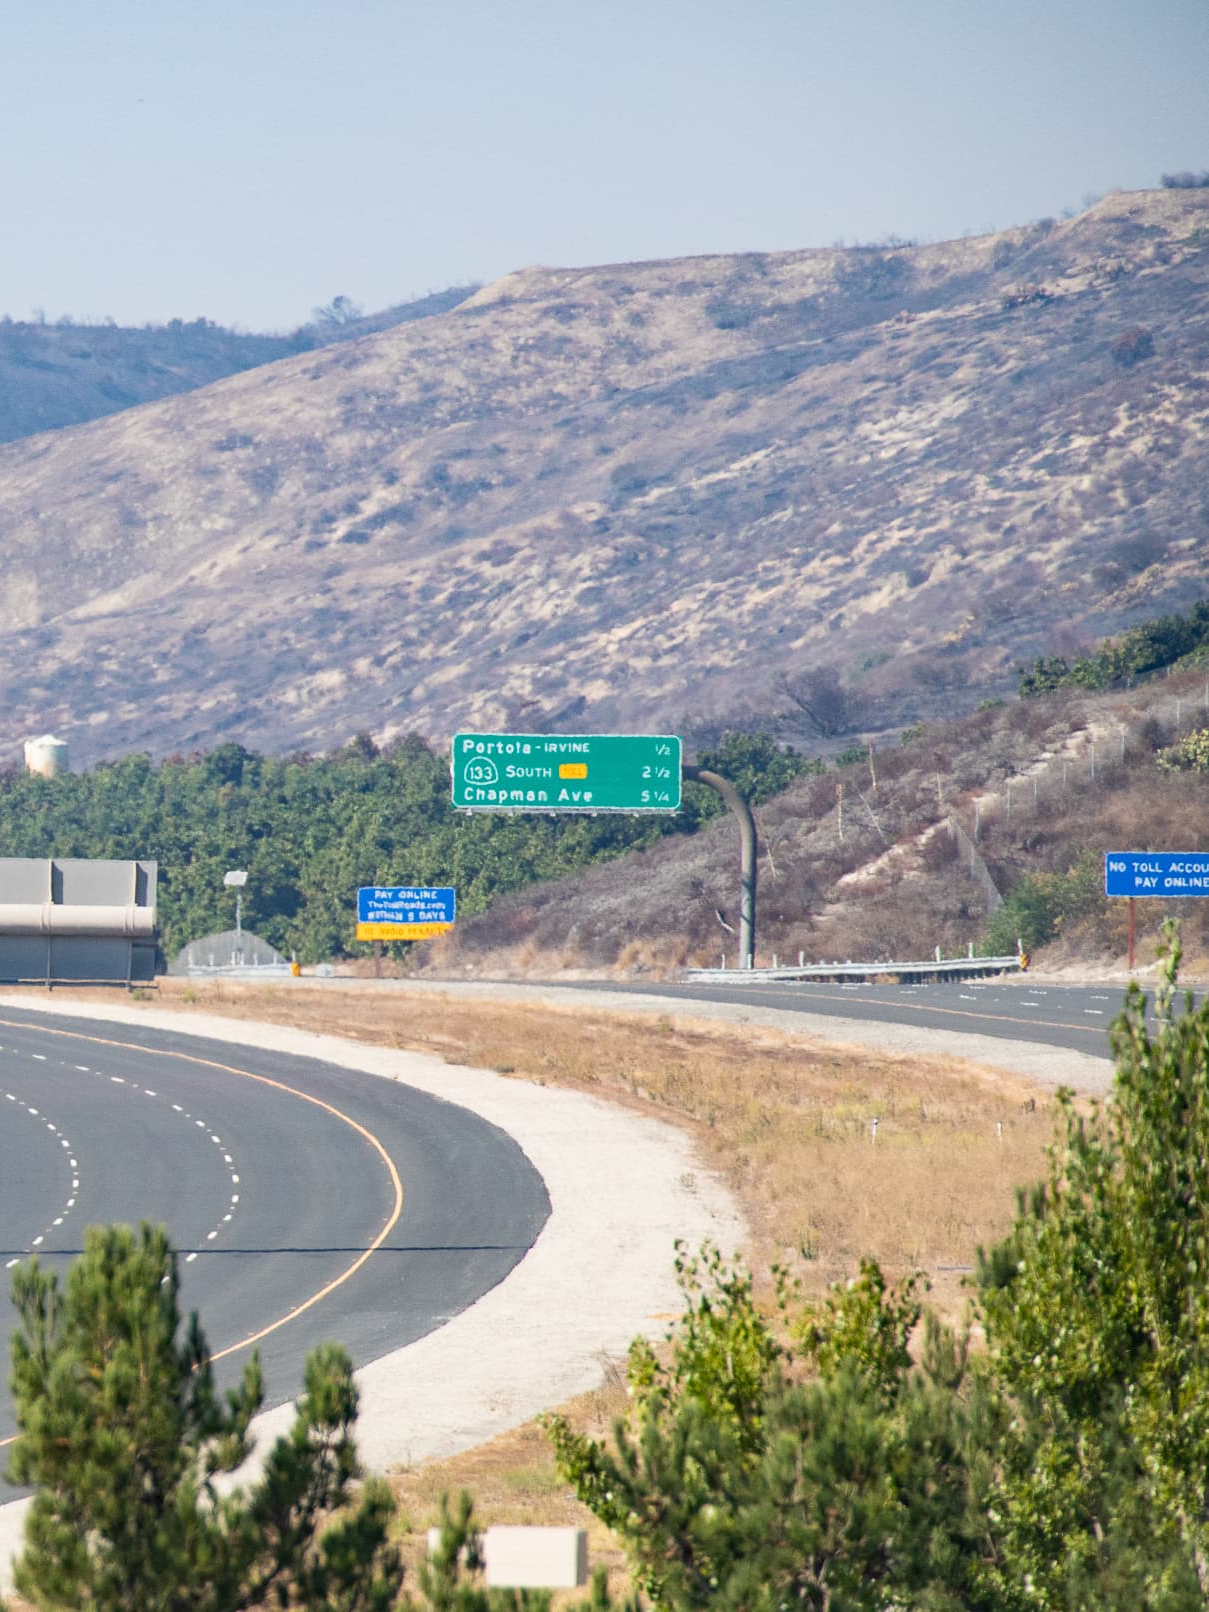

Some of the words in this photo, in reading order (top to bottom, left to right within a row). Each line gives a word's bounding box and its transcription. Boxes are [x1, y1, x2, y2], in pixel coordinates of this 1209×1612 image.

[462, 740, 531, 754] Portola
[544, 743, 590, 753] IRVINE
[470, 767, 493, 780] 133
[505, 765, 552, 777] SOUTH
[642, 766, 651, 778] 2
[464, 788, 548, 803] Chapman
[558, 789, 593, 802] Ave
[1109, 861, 1126, 872] NO
[1132, 862, 1163, 872] TOLL
[1135, 877, 1158, 887] PAY
[1164, 877, 1209, 887] ONLINE
[375, 891, 393, 899] PAY
[398, 891, 437, 899] ONLINE
[419, 911, 445, 920] DAYS
